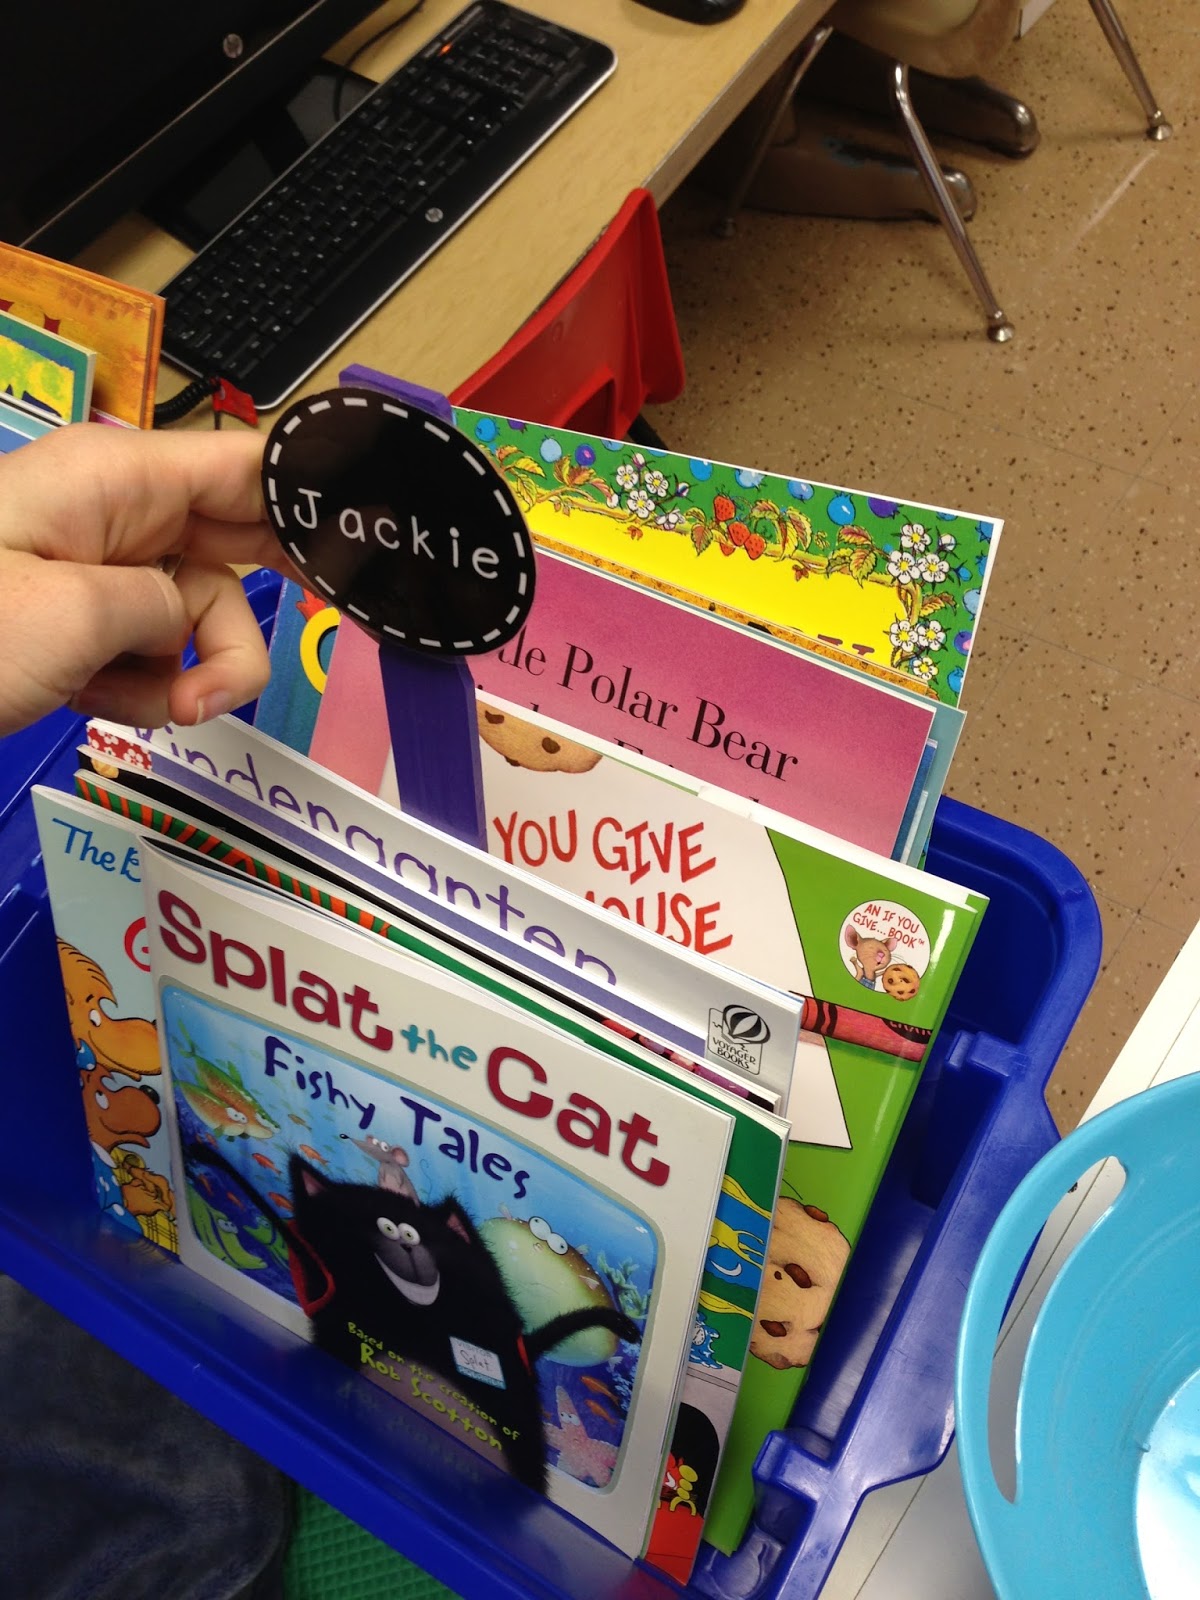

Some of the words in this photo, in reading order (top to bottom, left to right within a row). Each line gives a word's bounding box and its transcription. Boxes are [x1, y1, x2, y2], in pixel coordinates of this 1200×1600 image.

[293, 487, 500, 580] Jackie
[556, 641, 678, 730] Polar
[686, 696, 799, 782] Bear
[52, 817, 117, 872] The
[493, 809, 578, 867] YOU
[592, 820, 717, 886] GIVE
[864, 903, 882, 917] AN
[882, 910, 896, 922] IF
[897, 916, 920, 934] YOU
[158, 889, 395, 1052] Splat
[400, 1023, 479, 1071] the
[486, 1045, 671, 1188] Cat
[712, 1037, 757, 1065] VOYAGER
[717, 1047, 750, 1070] BOOKS
[264, 1035, 376, 1130] Fishy
[400, 1095, 531, 1200] Tales
[347, 1321, 383, 1350] Based
[387, 1350, 405, 1365] on
[439, 1383, 498, 1426] creation
[360, 1342, 401, 1381] Rob
[410, 1376, 503, 1451] Scotton
